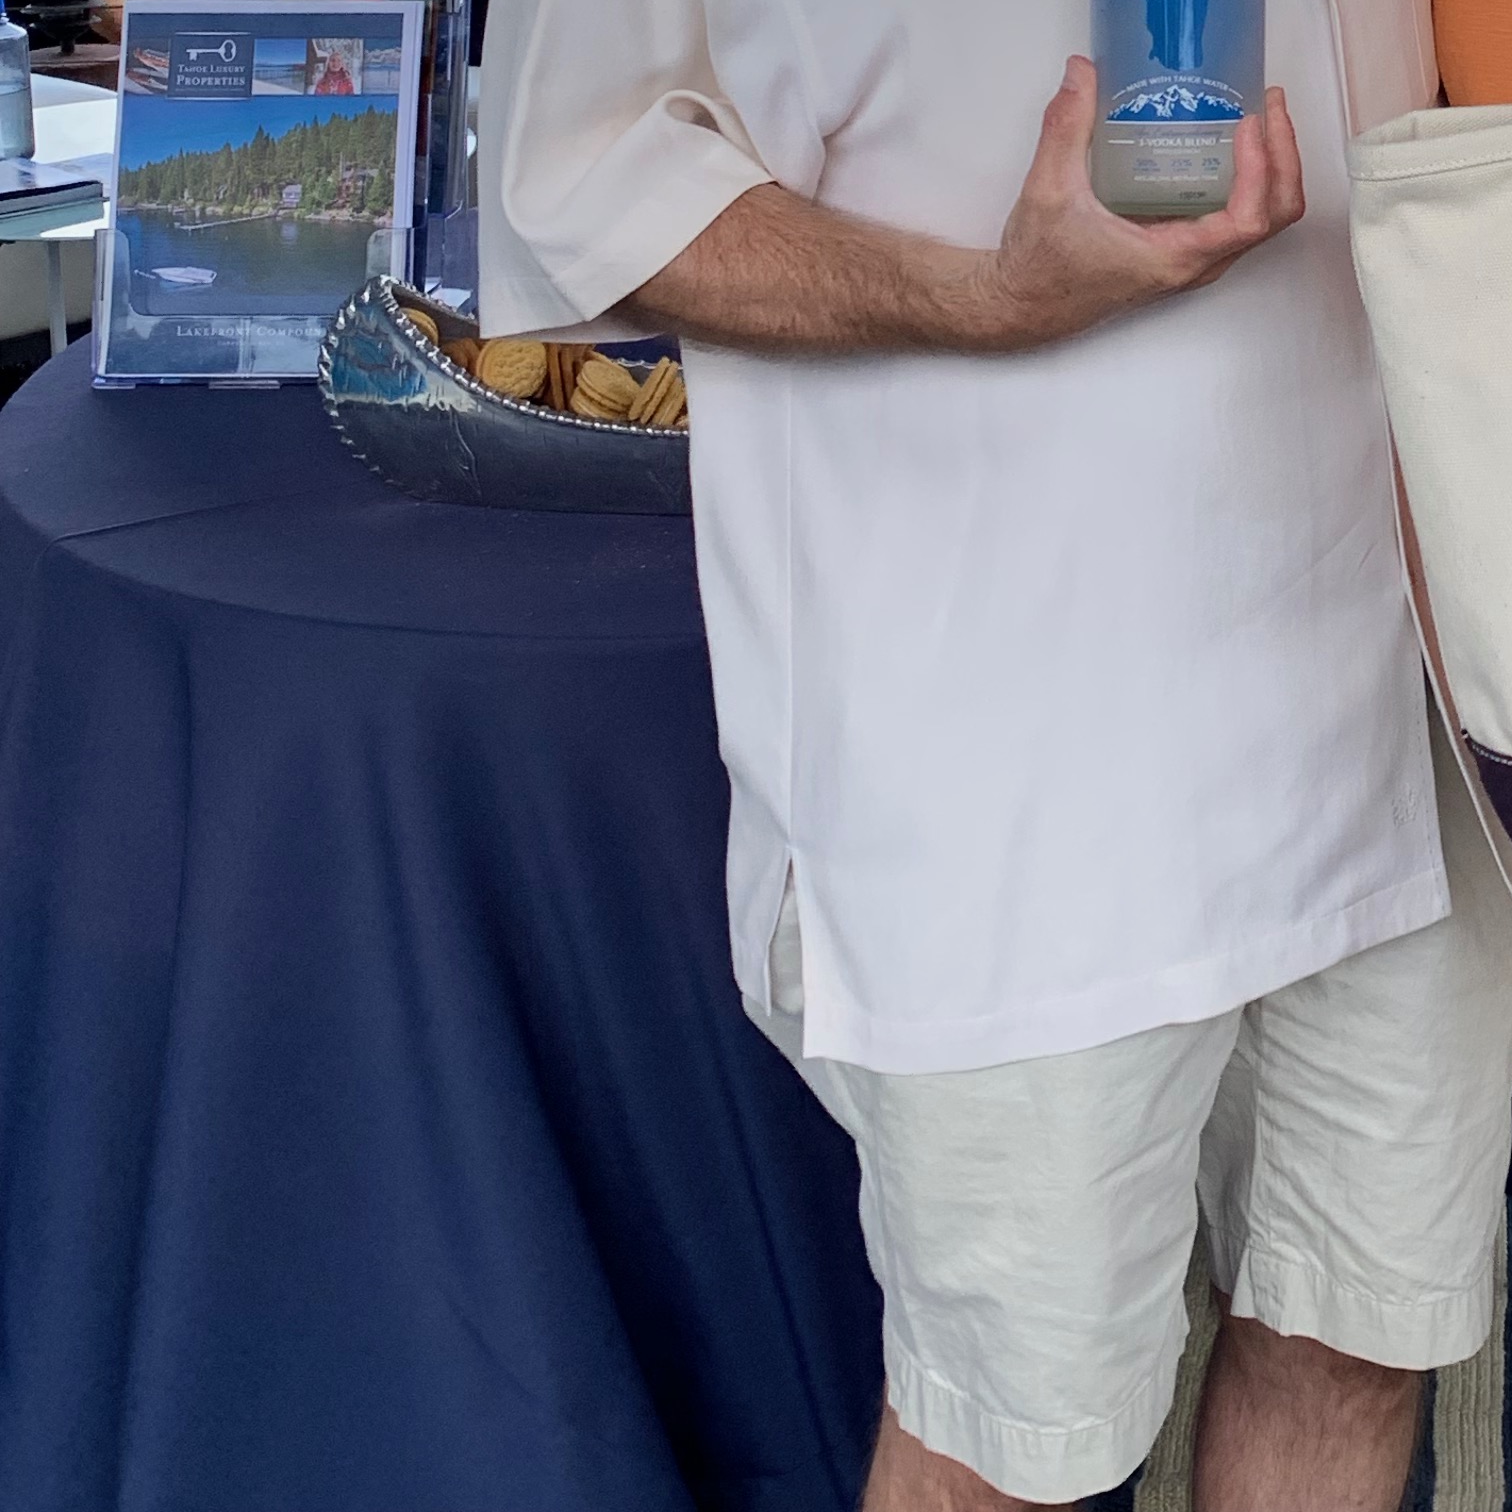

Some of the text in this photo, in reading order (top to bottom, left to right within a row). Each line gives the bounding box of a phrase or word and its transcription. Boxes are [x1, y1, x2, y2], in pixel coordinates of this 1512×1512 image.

[177, 64, 246, 73] TAHOE LUXURY
[176, 75, 246, 86] PROPERTIES
[176, 325, 250, 337] LAKEFRONT
